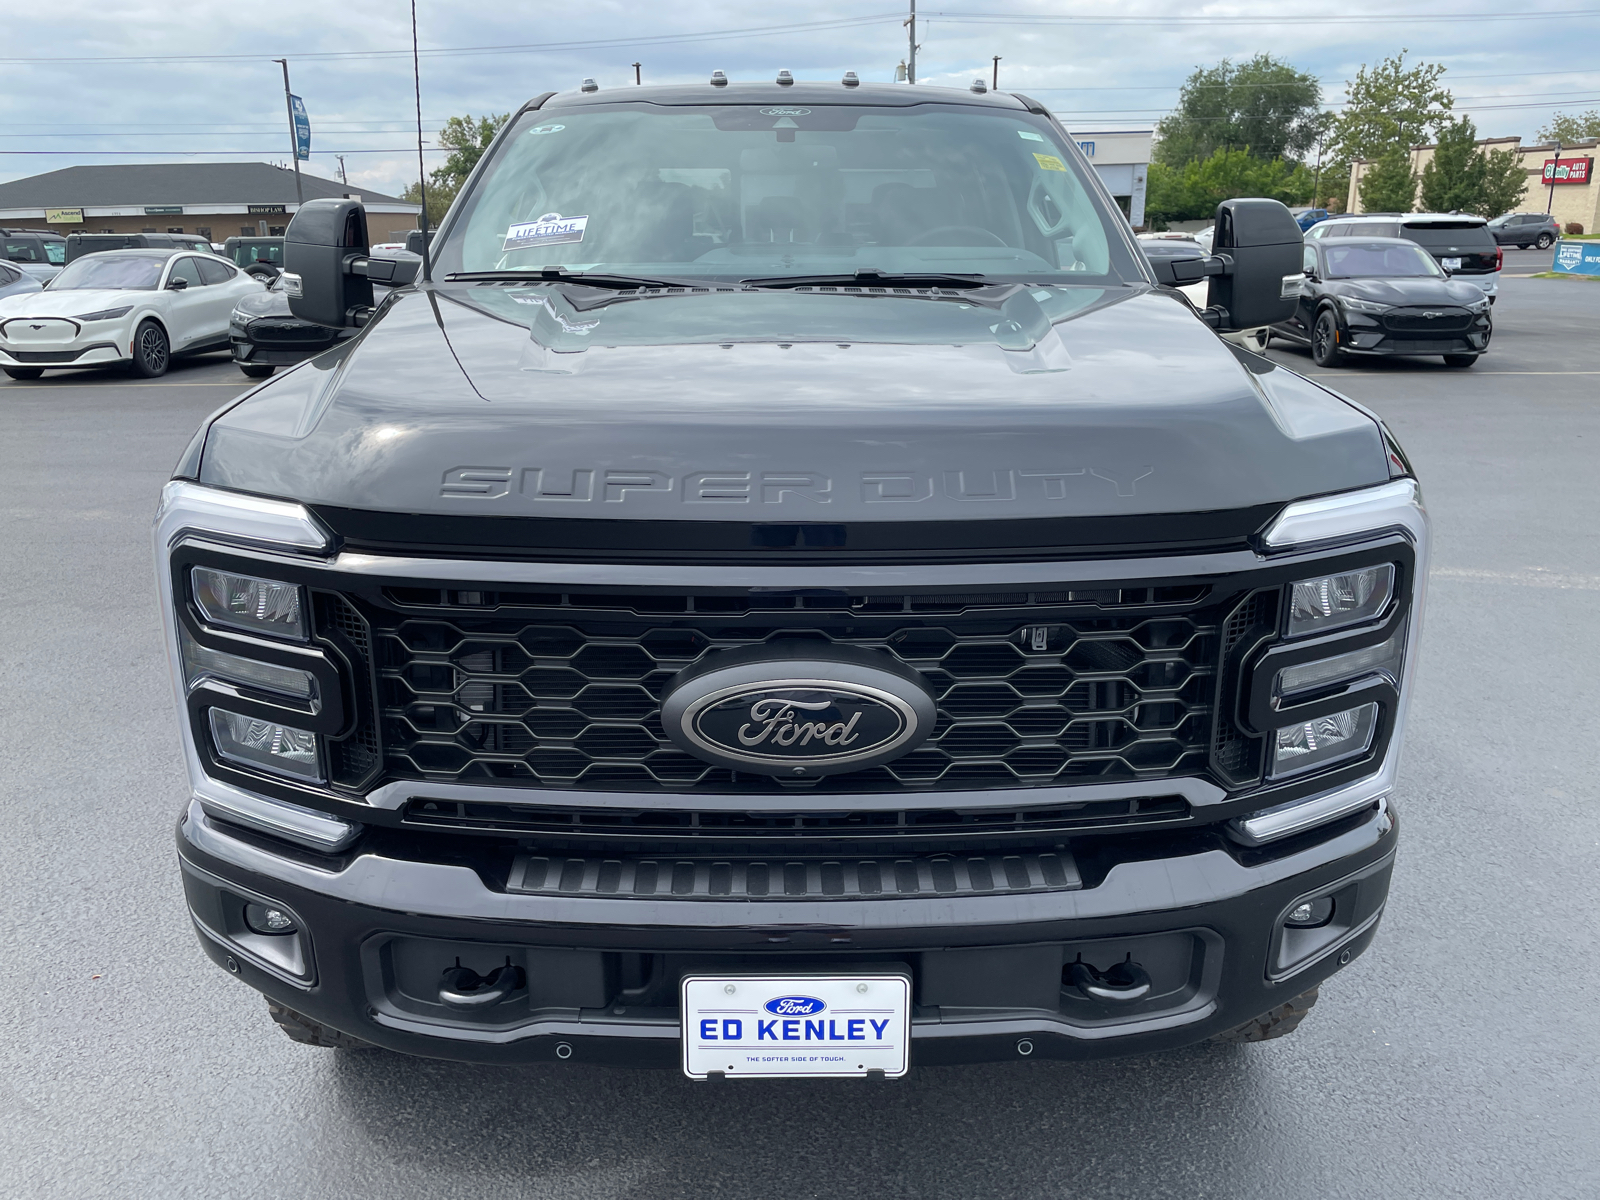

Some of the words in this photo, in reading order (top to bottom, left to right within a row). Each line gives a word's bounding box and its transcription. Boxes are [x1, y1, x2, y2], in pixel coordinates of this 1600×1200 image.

[768, 107, 802, 115] Ford
[515, 223, 577, 238] LIFETIME
[439, 465, 834, 505] SUPER
[861, 465, 1156, 504] DUTY
[737, 698, 862, 748] Ford
[776, 998, 814, 1015] Ford
[700, 1019, 743, 1040] ED
[757, 1019, 890, 1040] KENLEY
